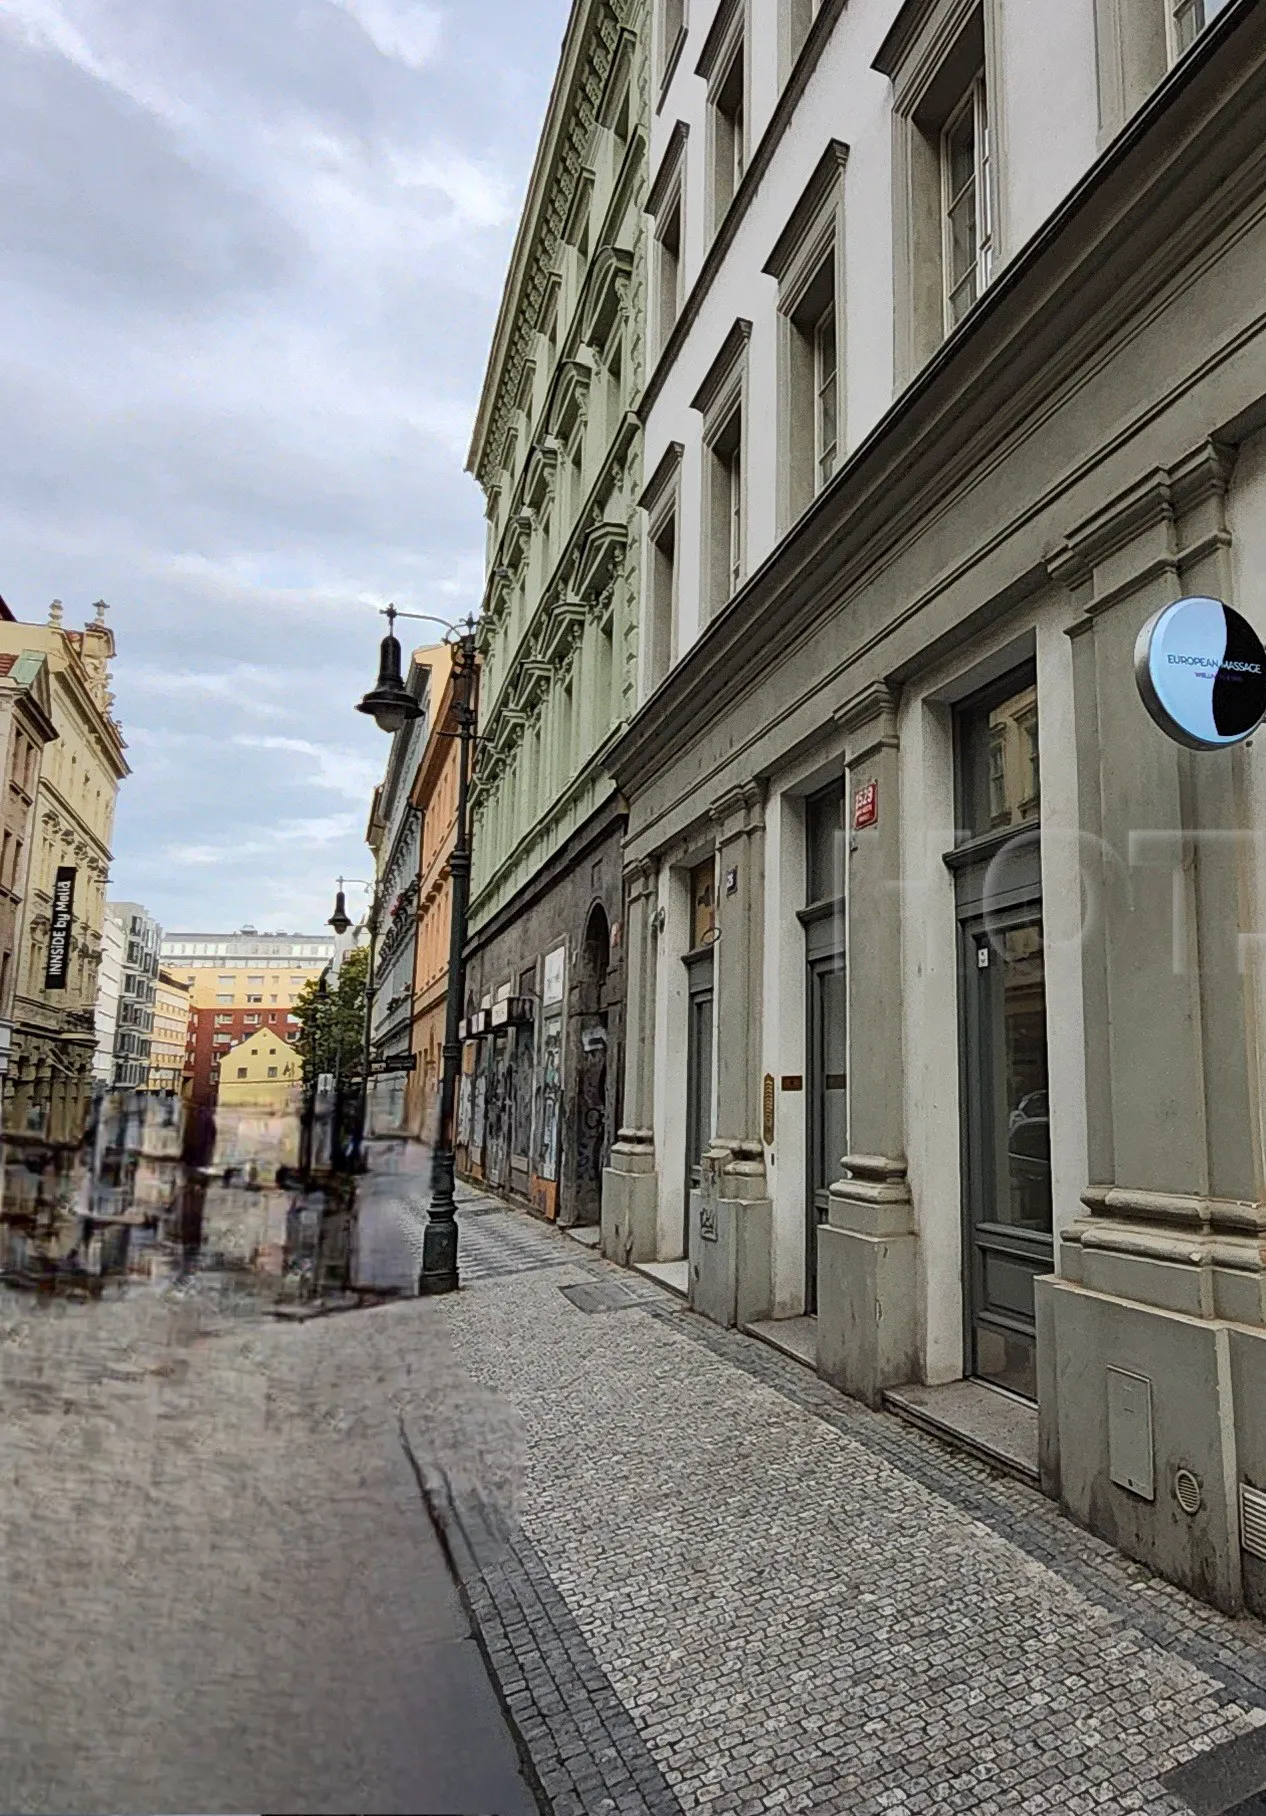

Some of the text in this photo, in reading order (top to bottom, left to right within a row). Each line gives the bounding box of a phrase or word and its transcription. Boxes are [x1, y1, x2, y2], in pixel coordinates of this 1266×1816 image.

[1167, 654, 1262, 674] EUROPEAN MASSAGE
[54, 913, 71, 928] by
[49, 930, 67, 975] INNSIDE
